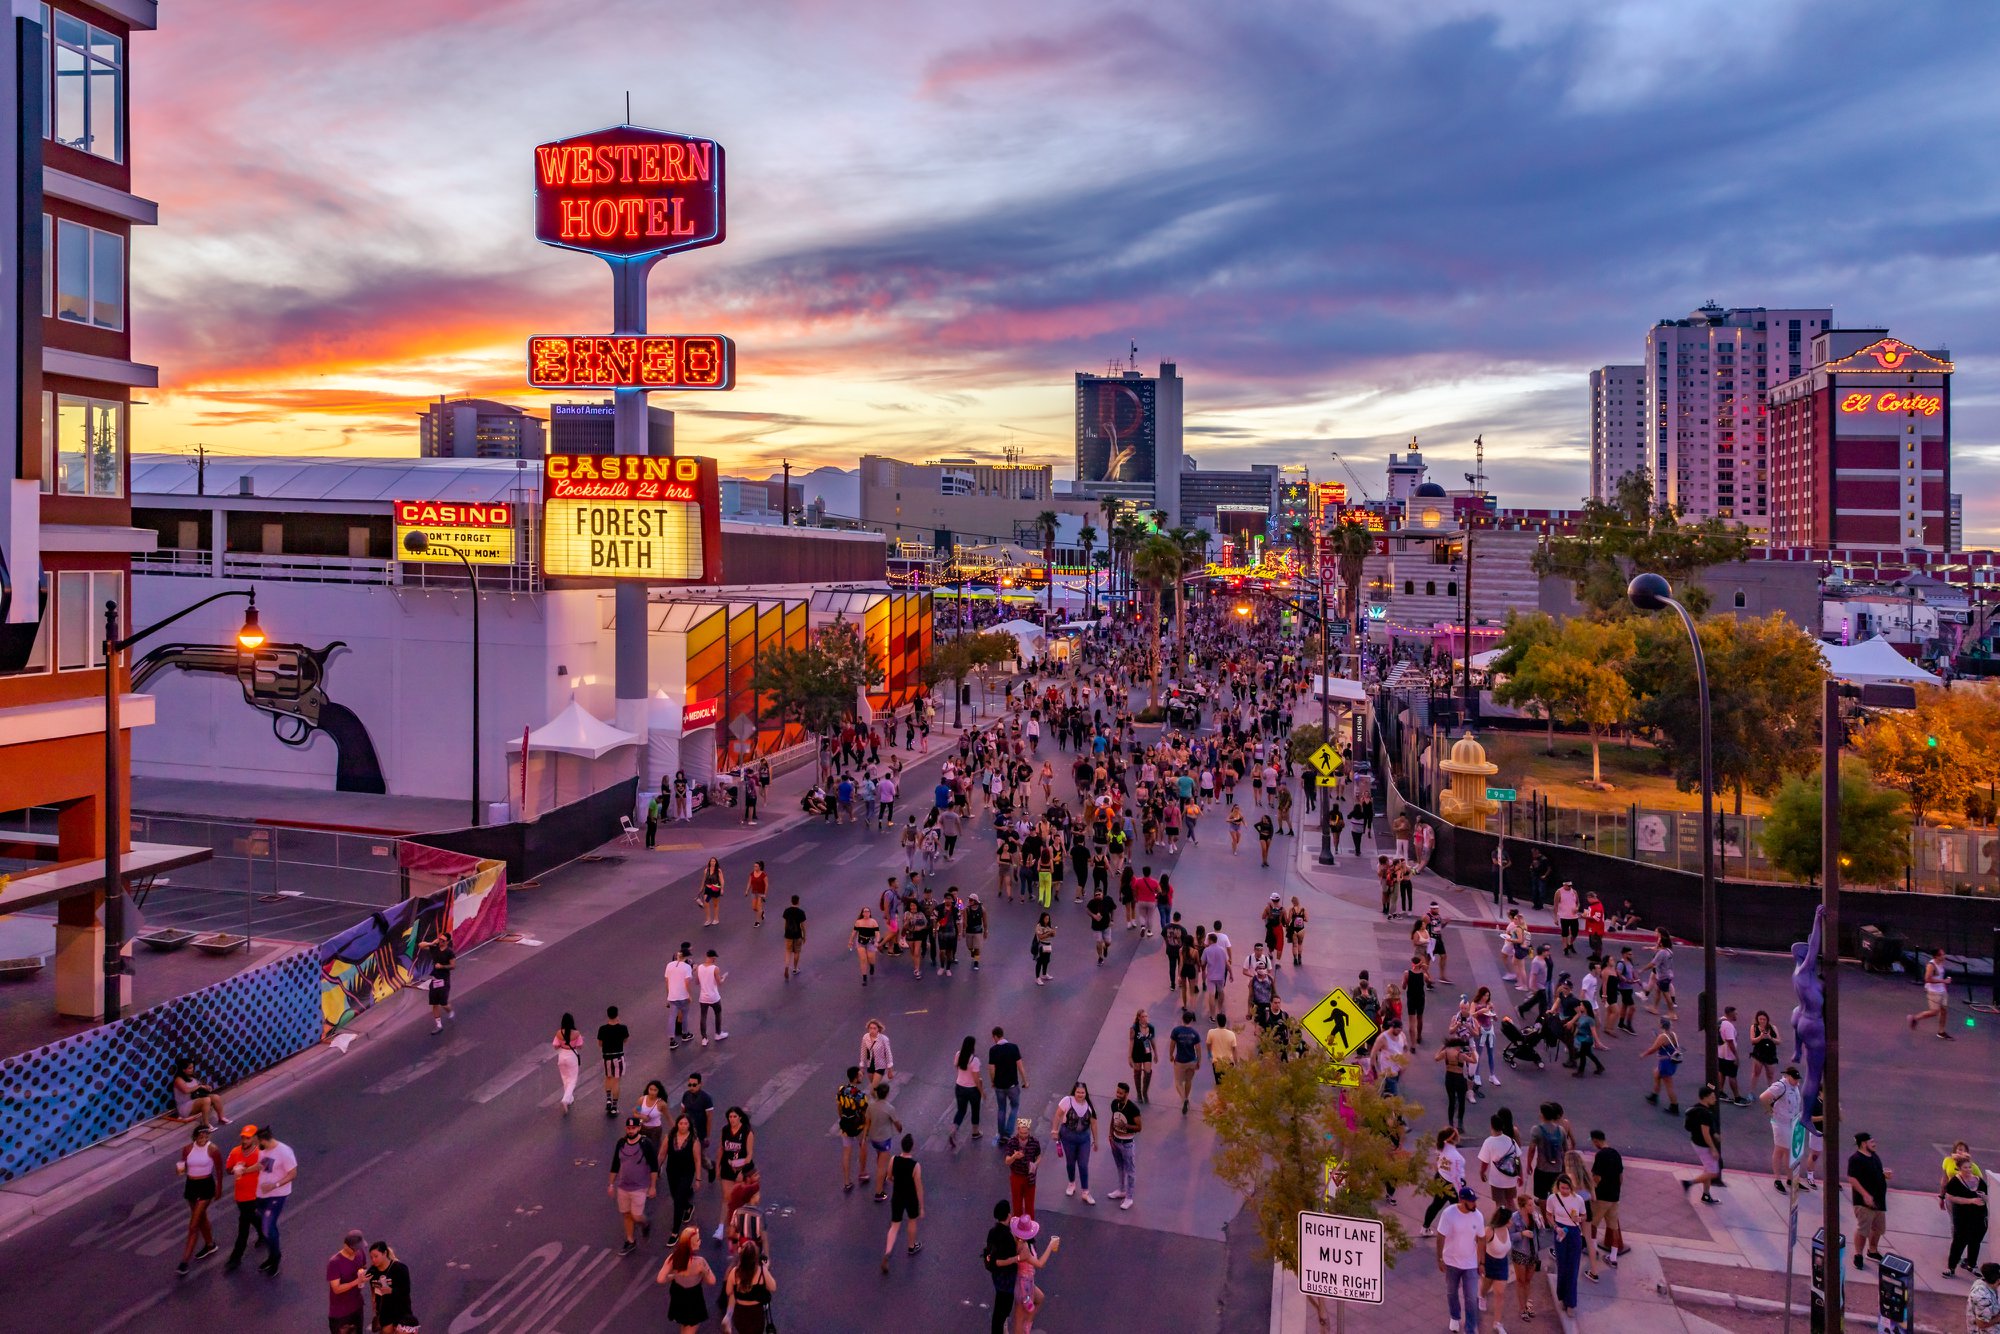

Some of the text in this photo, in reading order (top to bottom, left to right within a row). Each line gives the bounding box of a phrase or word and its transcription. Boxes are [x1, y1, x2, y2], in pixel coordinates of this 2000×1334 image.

[537, 142, 712, 184] WESTERN
[561, 197, 695, 237] HOTEL
[533, 338, 720, 383] BINGO
[556, 405, 576, 414] Bank
[576, 405, 585, 414] of
[1143, 384, 1151, 416] VEGAS
[1841, 393, 1941, 416] El Cortez
[548, 456, 697, 481] CASINO
[555, 479, 629, 497] Cocktails
[636, 482, 659, 498] 24
[402, 506, 507, 523] CASINO
[576, 507, 668, 537] FOREST
[424, 533, 492, 543] ON'T FORGET
[474, 549, 500, 558] MOM!
[591, 539, 651, 569] BATH
[1205, 563, 1251, 577] Fremont
[689, 708, 710, 721] MEDICAL
[1305, 1222, 1376, 1243] RIGHT LANE
[1319, 1246, 1364, 1266] MUST
[1305, 1269, 1378, 1290] TURN RIGHT
[1306, 1283, 1375, 1300] BUSSES EXEMPT
